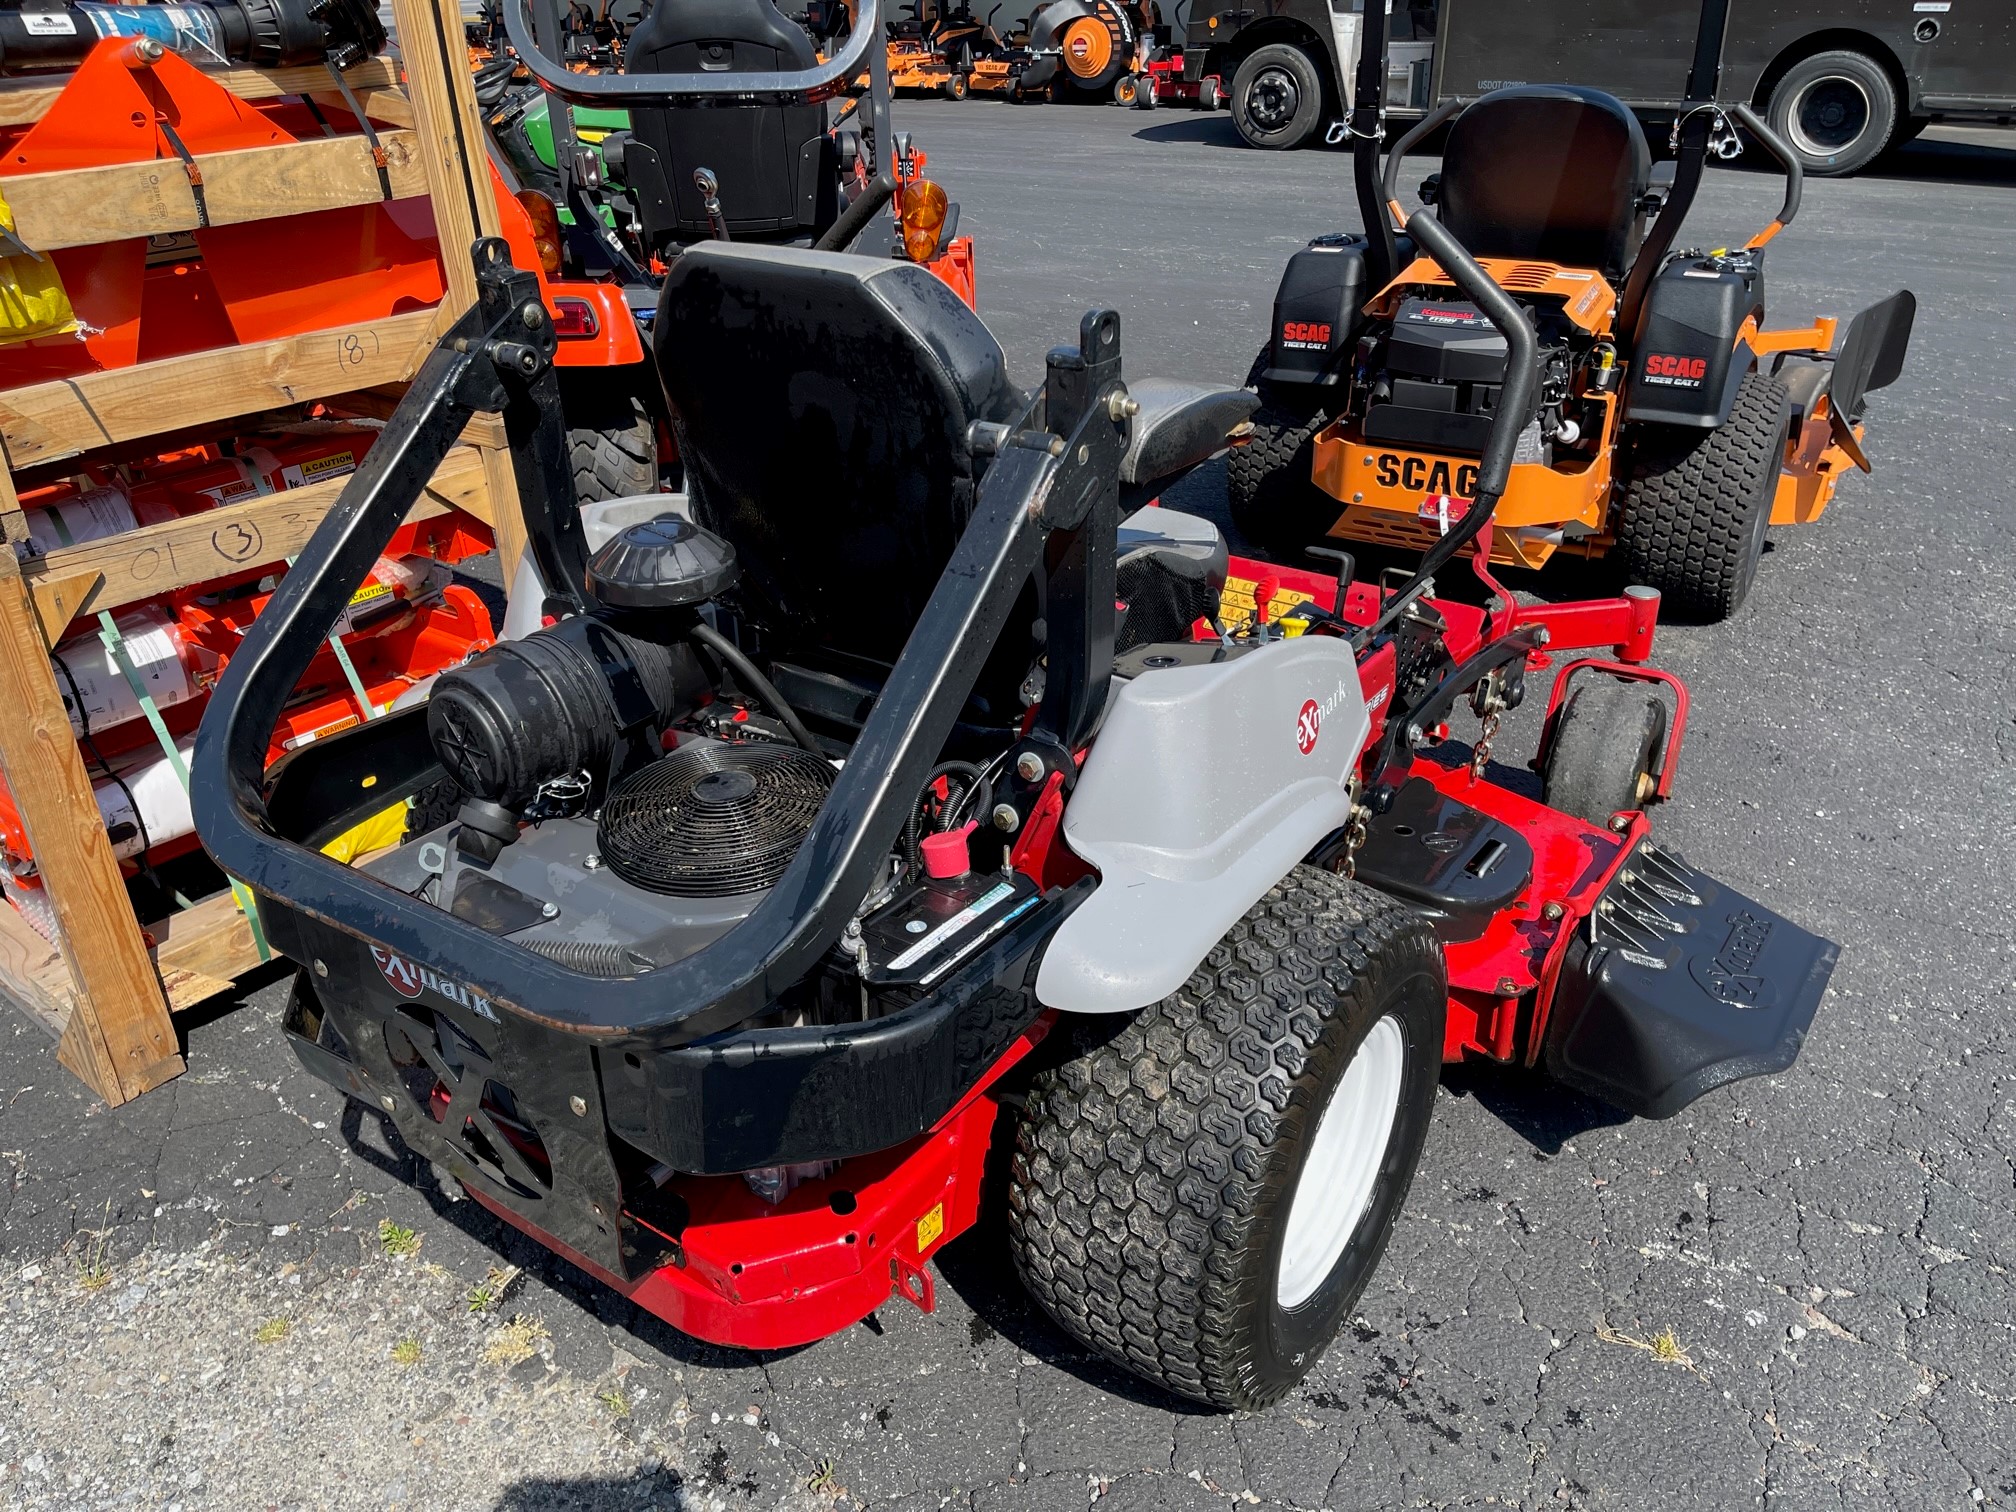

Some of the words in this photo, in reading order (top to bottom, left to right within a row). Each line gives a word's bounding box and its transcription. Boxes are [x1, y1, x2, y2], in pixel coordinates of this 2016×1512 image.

[1477, 80, 1502, 90] USDOT
[1421, 308, 1475, 319] Kawasaki
[1284, 322, 1331, 343] SCAG
[1646, 355, 1707, 379] SCAG
[1644, 375, 1673, 385] TIGER
[1673, 378, 1693, 387] CAT
[312, 454, 353, 471] CAUTION
[1376, 454, 1480, 498] SCAG
[352, 585, 392, 601] CAUTION
[1296, 680, 1346, 750] eXmark
[323, 718, 357, 736] WARNING
[1706, 909, 1773, 1002] eXmark
